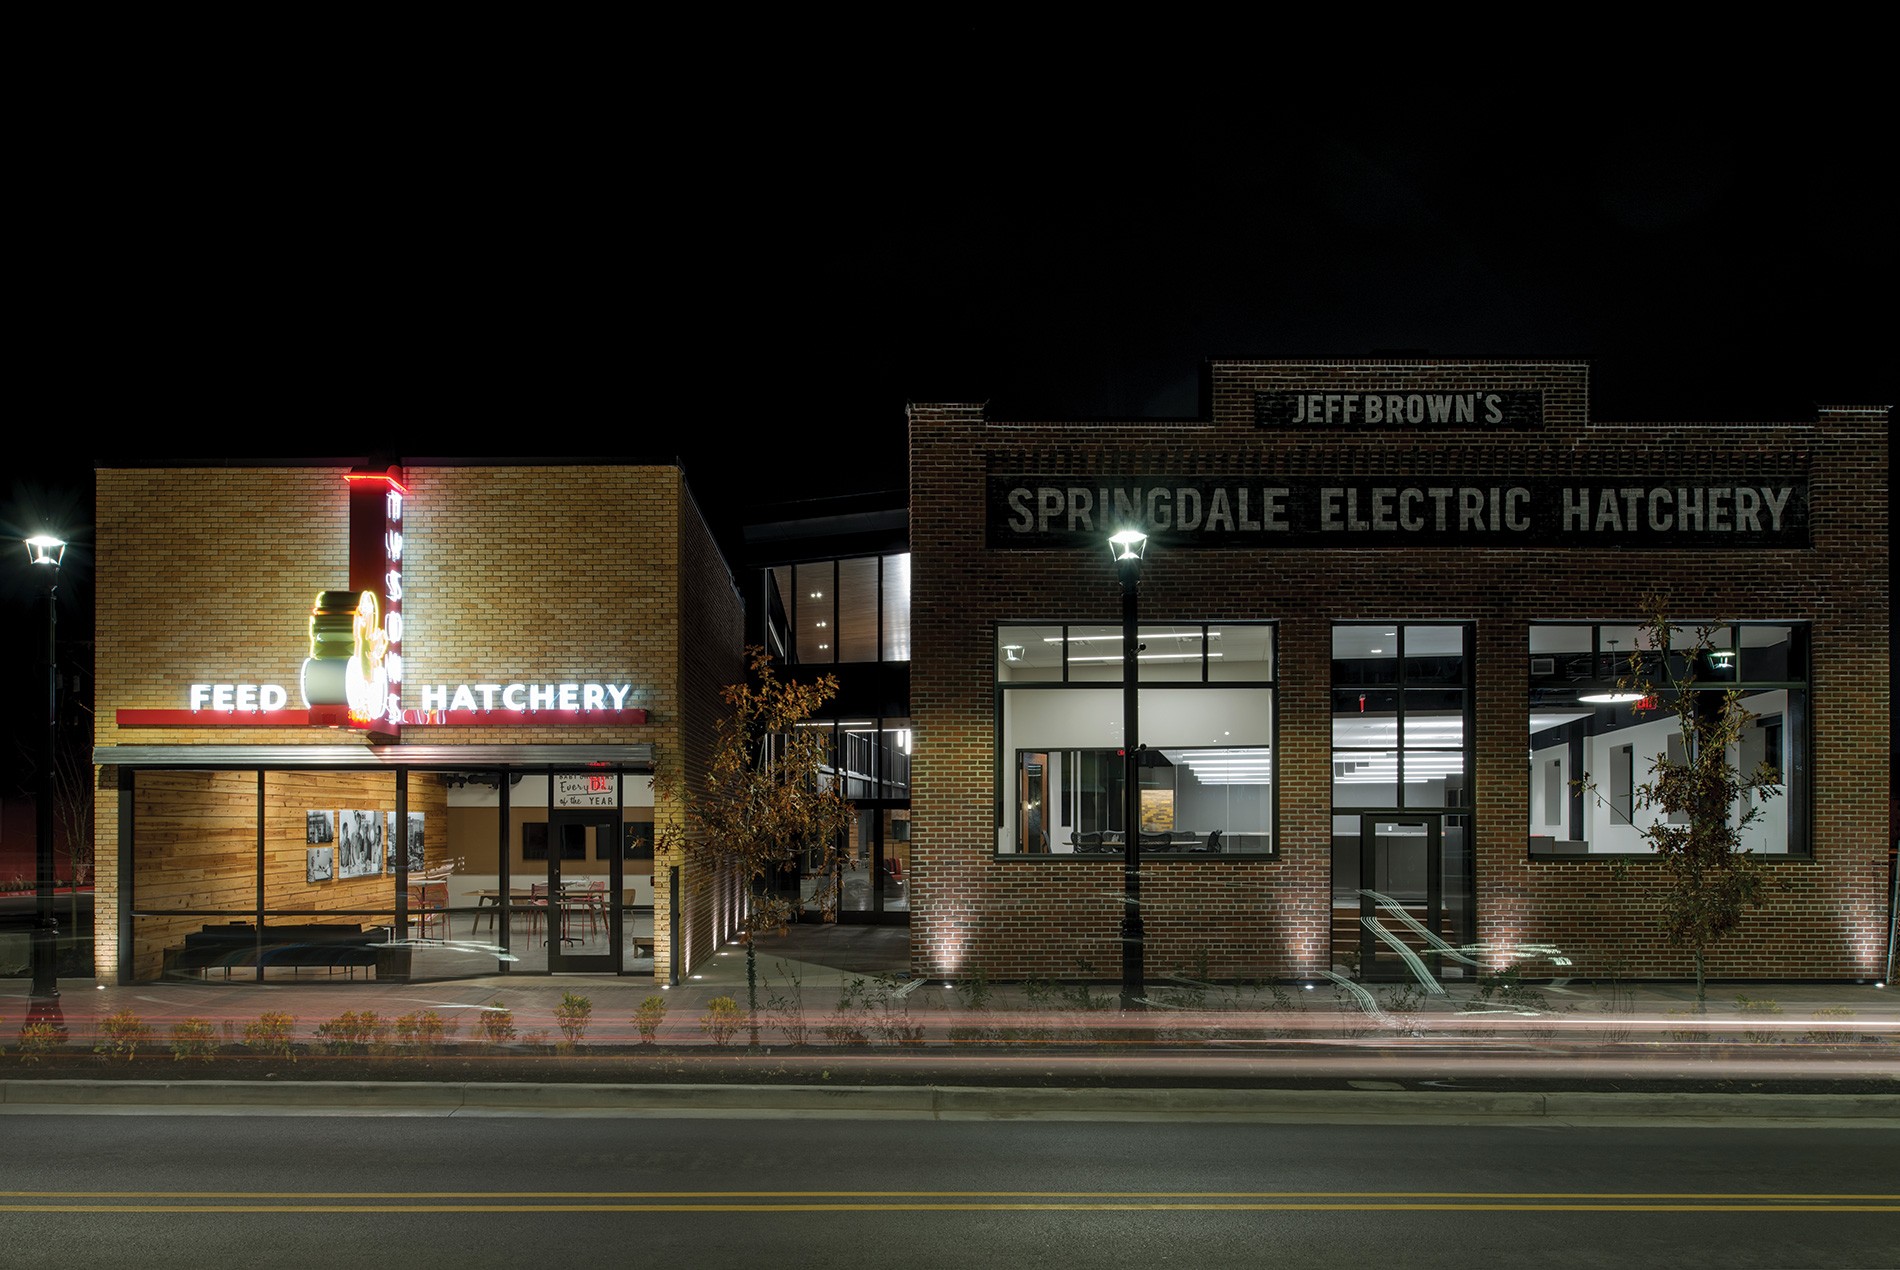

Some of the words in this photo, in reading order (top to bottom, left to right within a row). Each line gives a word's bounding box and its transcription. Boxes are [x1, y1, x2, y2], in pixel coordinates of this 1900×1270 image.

[1292, 394, 1359, 424] JEFF
[1365, 392, 1503, 424] BROWN'S
[1007, 486, 1291, 533] SPRINGDALE
[1320, 486, 1532, 533] ELECTRIC
[1562, 486, 1792, 533] HATCHERY
[190, 684, 287, 711] FEED
[422, 684, 631, 711] HATCHERY
[559, 780, 588, 794] Every
[559, 797, 568, 806] of
[570, 796, 582, 805] the
[589, 797, 613, 805] YEAR
